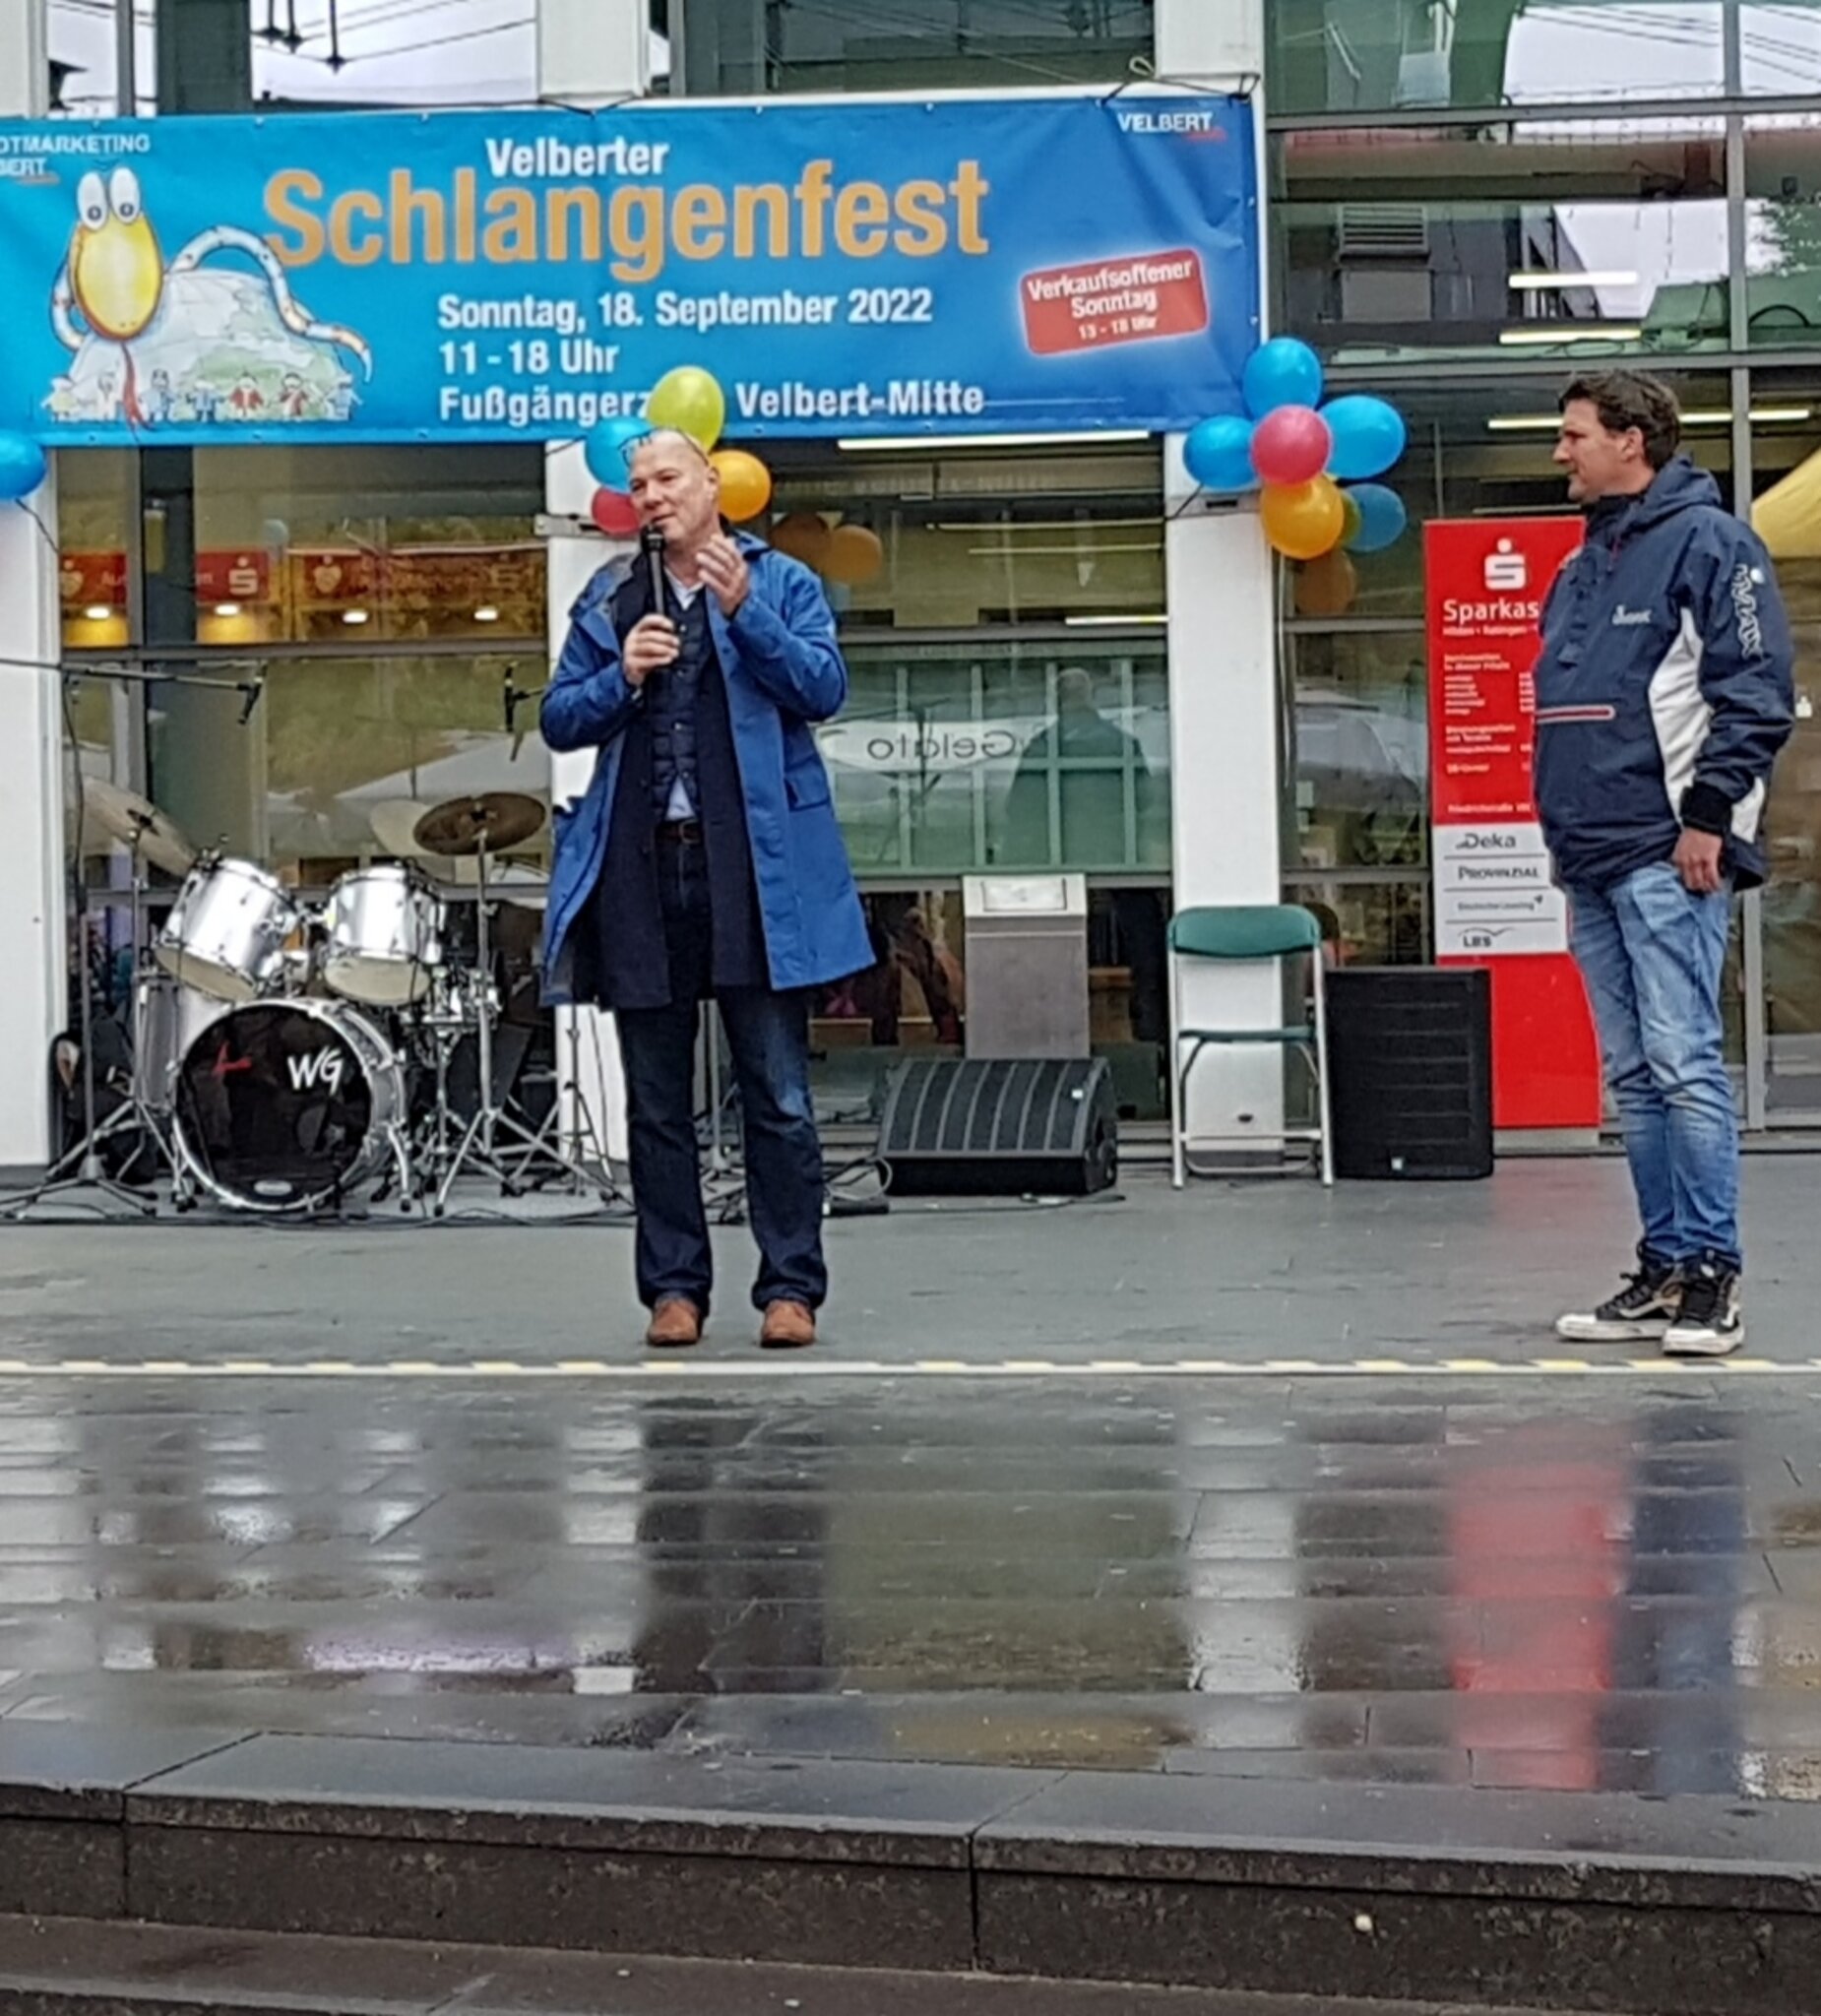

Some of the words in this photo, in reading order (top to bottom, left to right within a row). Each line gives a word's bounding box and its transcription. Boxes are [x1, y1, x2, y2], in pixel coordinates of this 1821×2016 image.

[1117, 111, 1213, 133] VELBERT
[485, 136, 670, 177] Velberter
[263, 159, 990, 283] Schlangenfest
[1028, 260, 1193, 301] Verkaufsoffener
[438, 293, 587, 335] Sonntag,
[597, 291, 643, 327] 18.
[656, 289, 839, 333] September
[848, 287, 933, 323] 2022
[1071, 289, 1158, 320] Sonntag
[439, 341, 476, 375] 11
[508, 340, 550, 375] 18
[560, 338, 620, 374] Uhr
[735, 380, 983, 417] Velbert-Mitte
[1457, 833, 1517, 849] Deka
